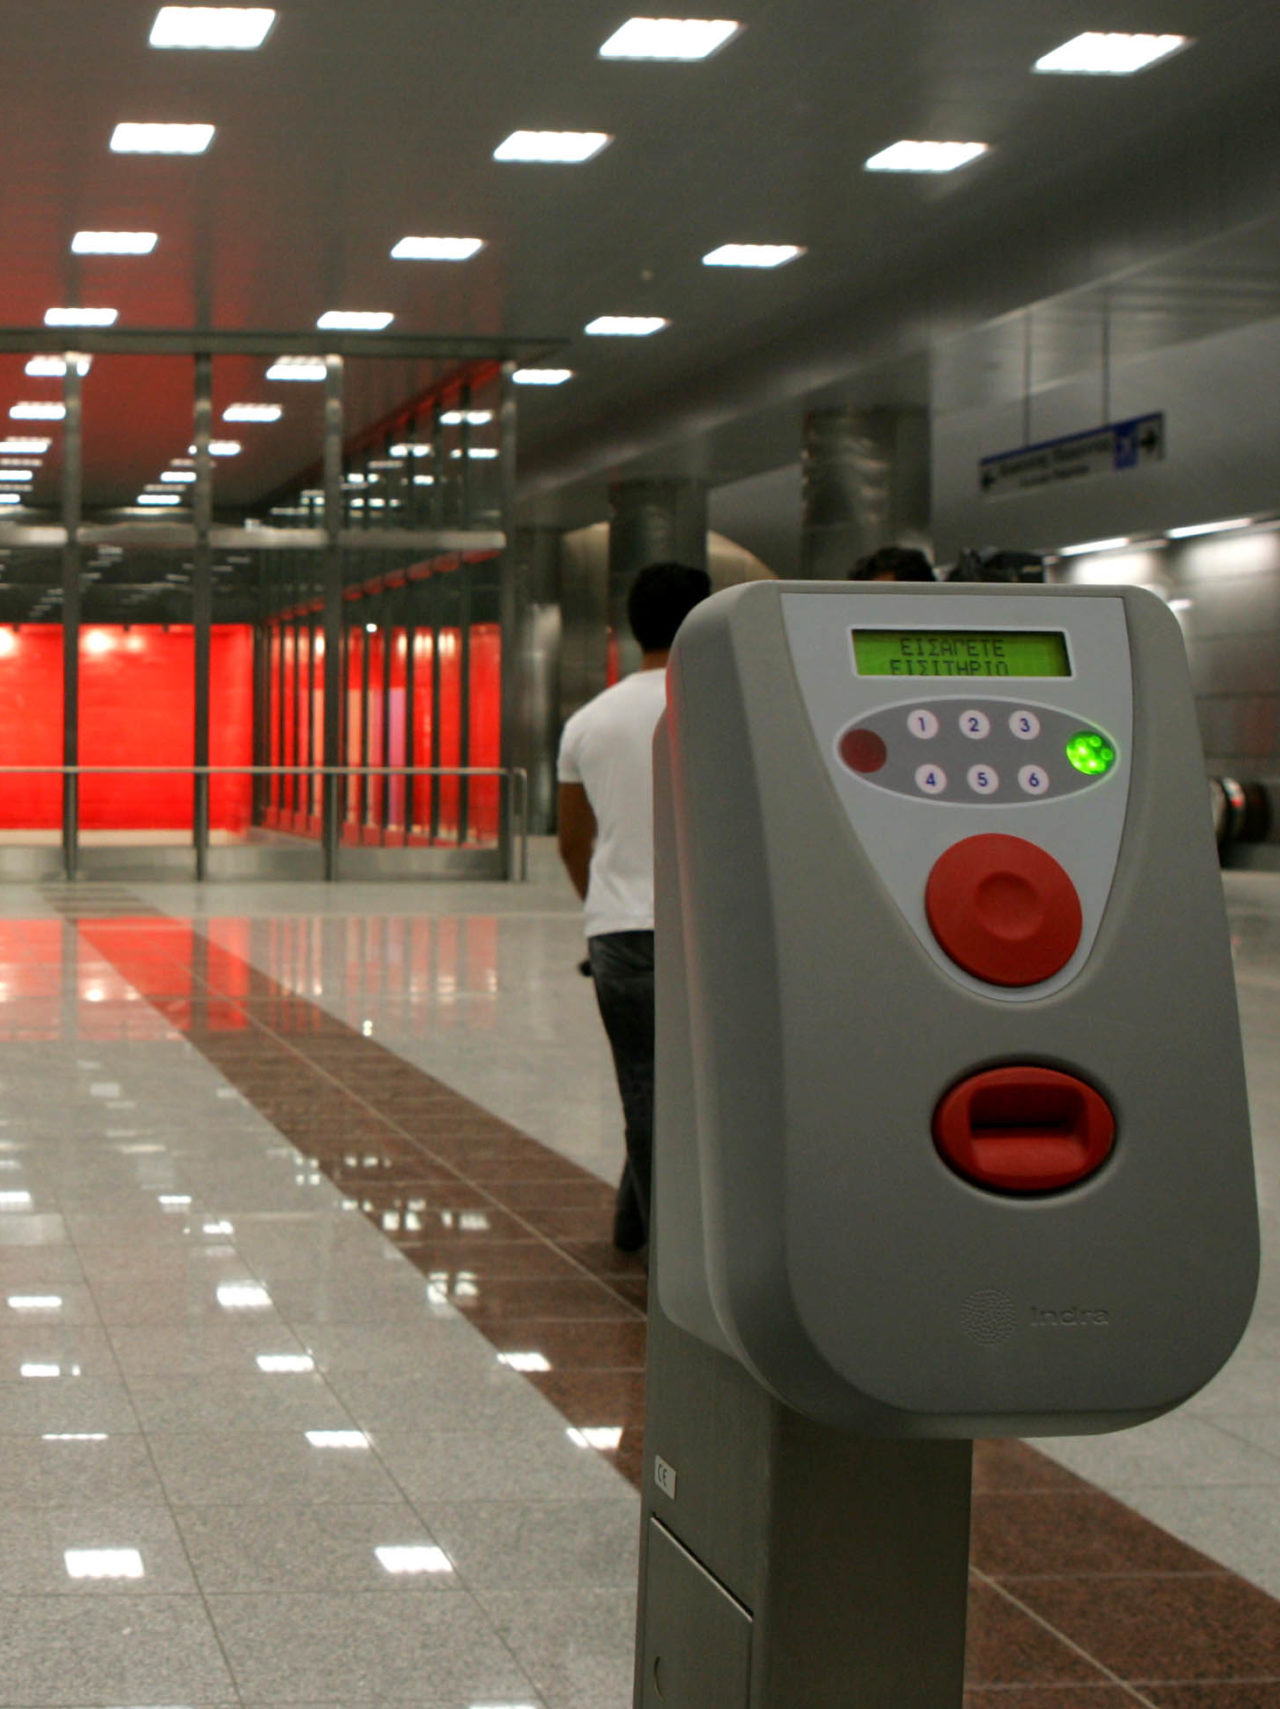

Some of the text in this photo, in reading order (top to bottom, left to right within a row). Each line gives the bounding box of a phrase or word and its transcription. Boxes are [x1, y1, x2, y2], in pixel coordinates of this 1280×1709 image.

[900, 638, 1006, 657] ΕΙΣΑΓΕΤΕ
[918, 716, 1031, 733] 1 2 3
[925, 772, 1040, 788] 4 5 6
